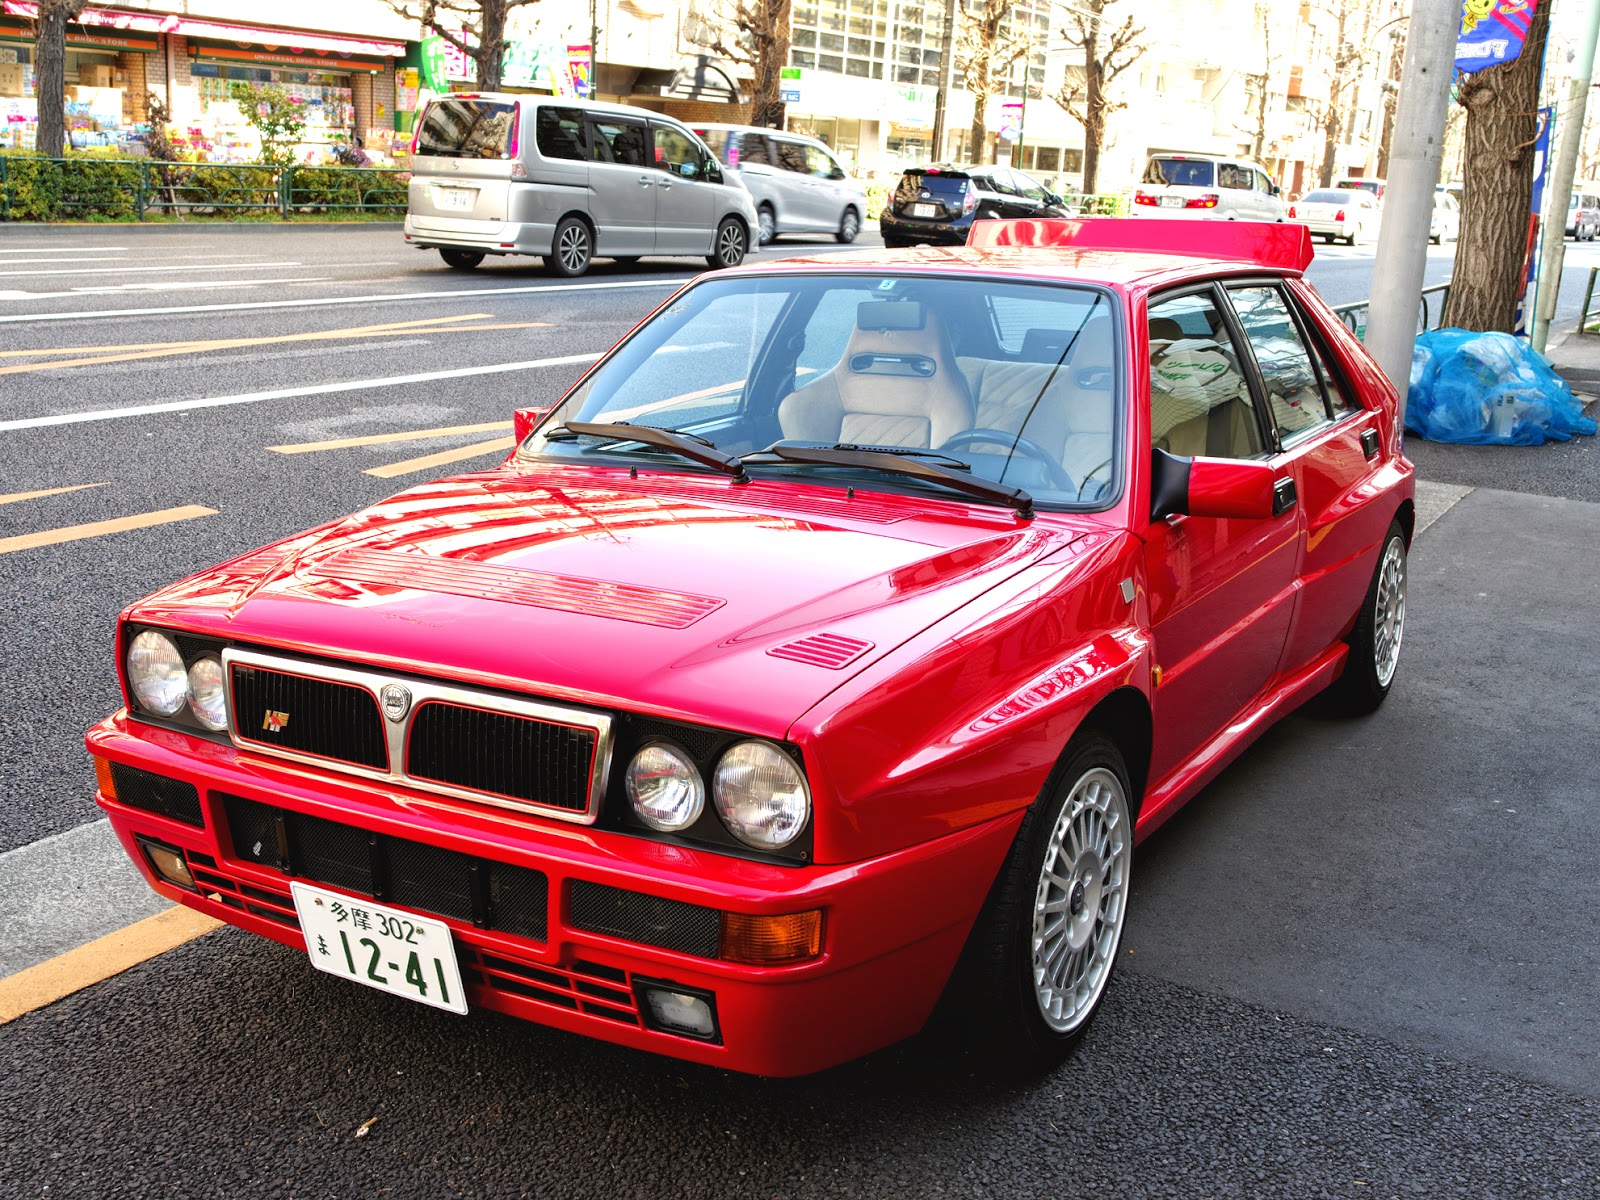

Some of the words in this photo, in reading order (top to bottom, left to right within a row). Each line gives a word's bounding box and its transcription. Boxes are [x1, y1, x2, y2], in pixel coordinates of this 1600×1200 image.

[74, 35, 99, 44] DRUG
[254, 54, 294, 63] UNIVERSAL
[296, 57, 315, 65] DRUG
[316, 59, 338, 67] STORE
[331, 902, 372, 931] 多摩
[375, 913, 418, 945] 302
[339, 929, 450, 1004] 12-41
